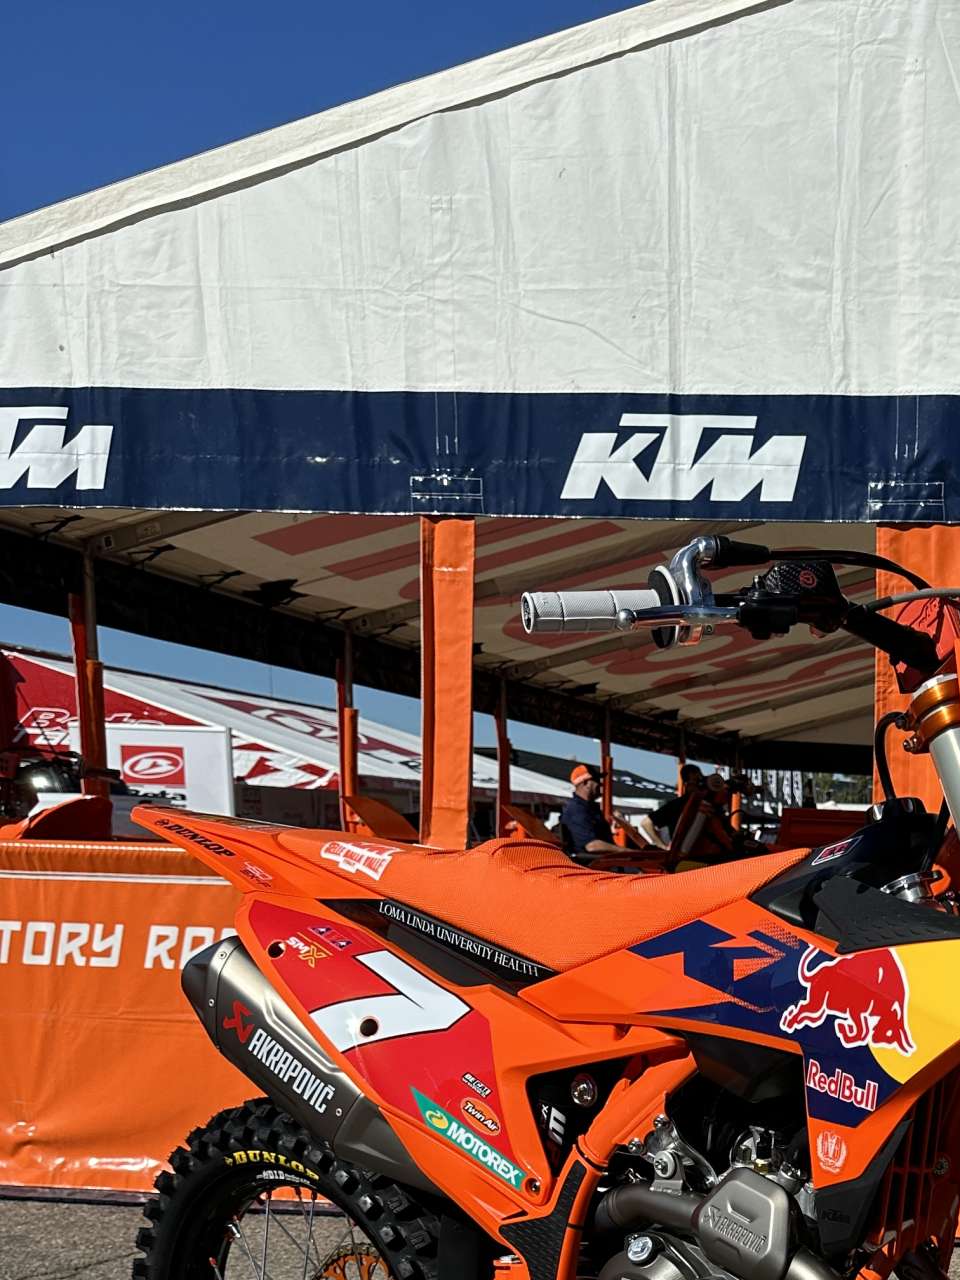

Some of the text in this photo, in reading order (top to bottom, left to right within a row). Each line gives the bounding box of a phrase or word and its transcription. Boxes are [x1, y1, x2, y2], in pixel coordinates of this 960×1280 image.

[0, 406, 113, 490] TM
[560, 413, 806, 502] KTM
[166, 822, 235, 858] DUNLOP
[0, 921, 124, 967] TORY
[379, 902, 539, 977] LOMA LINDA UNIVERSITY HEALTH
[308, 949, 474, 1054] 7
[248, 1028, 336, 1114] AKRAPOVIČ
[807, 1059, 878, 1112] Red Bull
[463, 1101, 499, 1132] Twin Air
[232, 1150, 320, 1180] DUNLOP
[447, 1121, 519, 1186] MOTOREX
